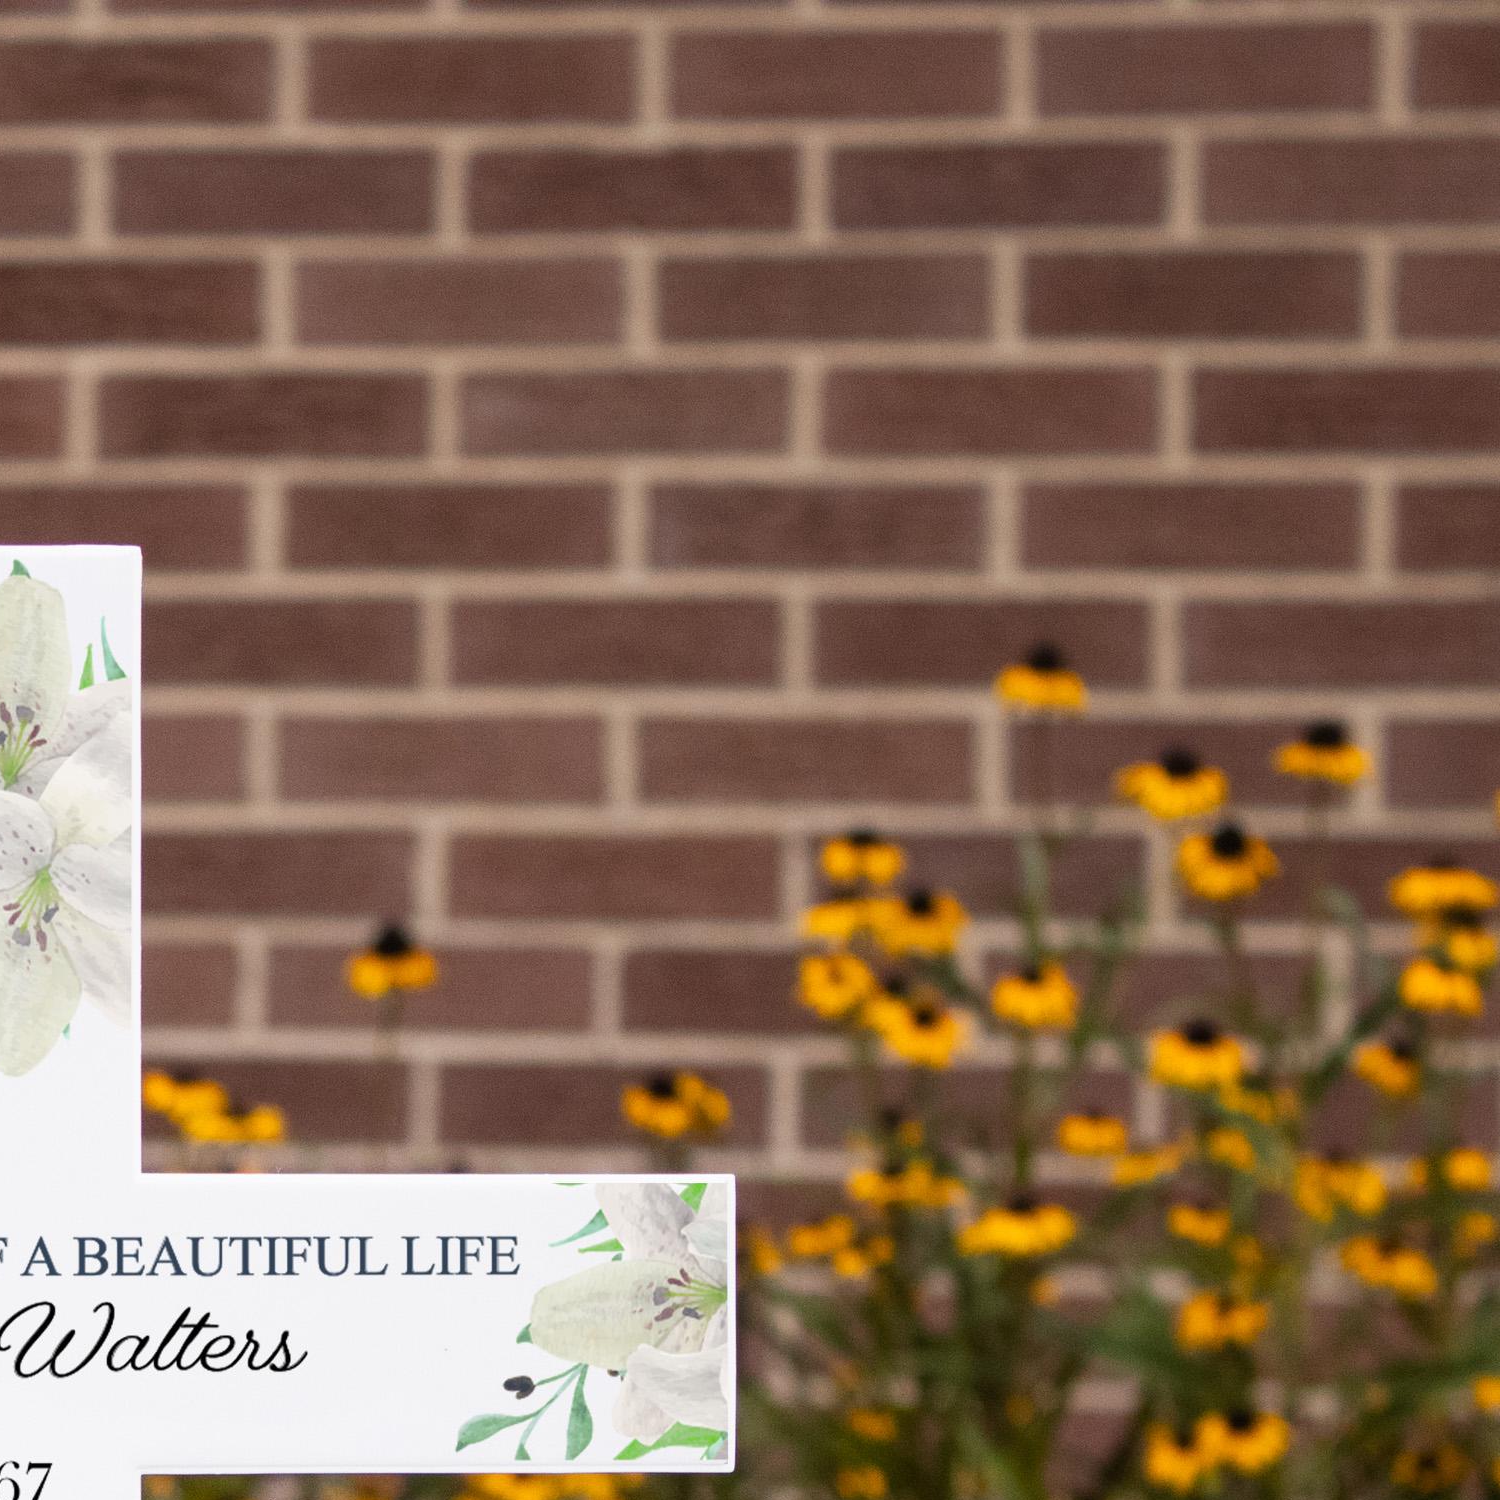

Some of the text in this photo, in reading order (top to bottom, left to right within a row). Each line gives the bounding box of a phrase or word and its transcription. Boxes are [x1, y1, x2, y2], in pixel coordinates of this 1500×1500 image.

[20, 1236, 62, 1277] A
[73, 1236, 389, 1277] BEAUTIFUL
[401, 1236, 521, 1276] LIFE
